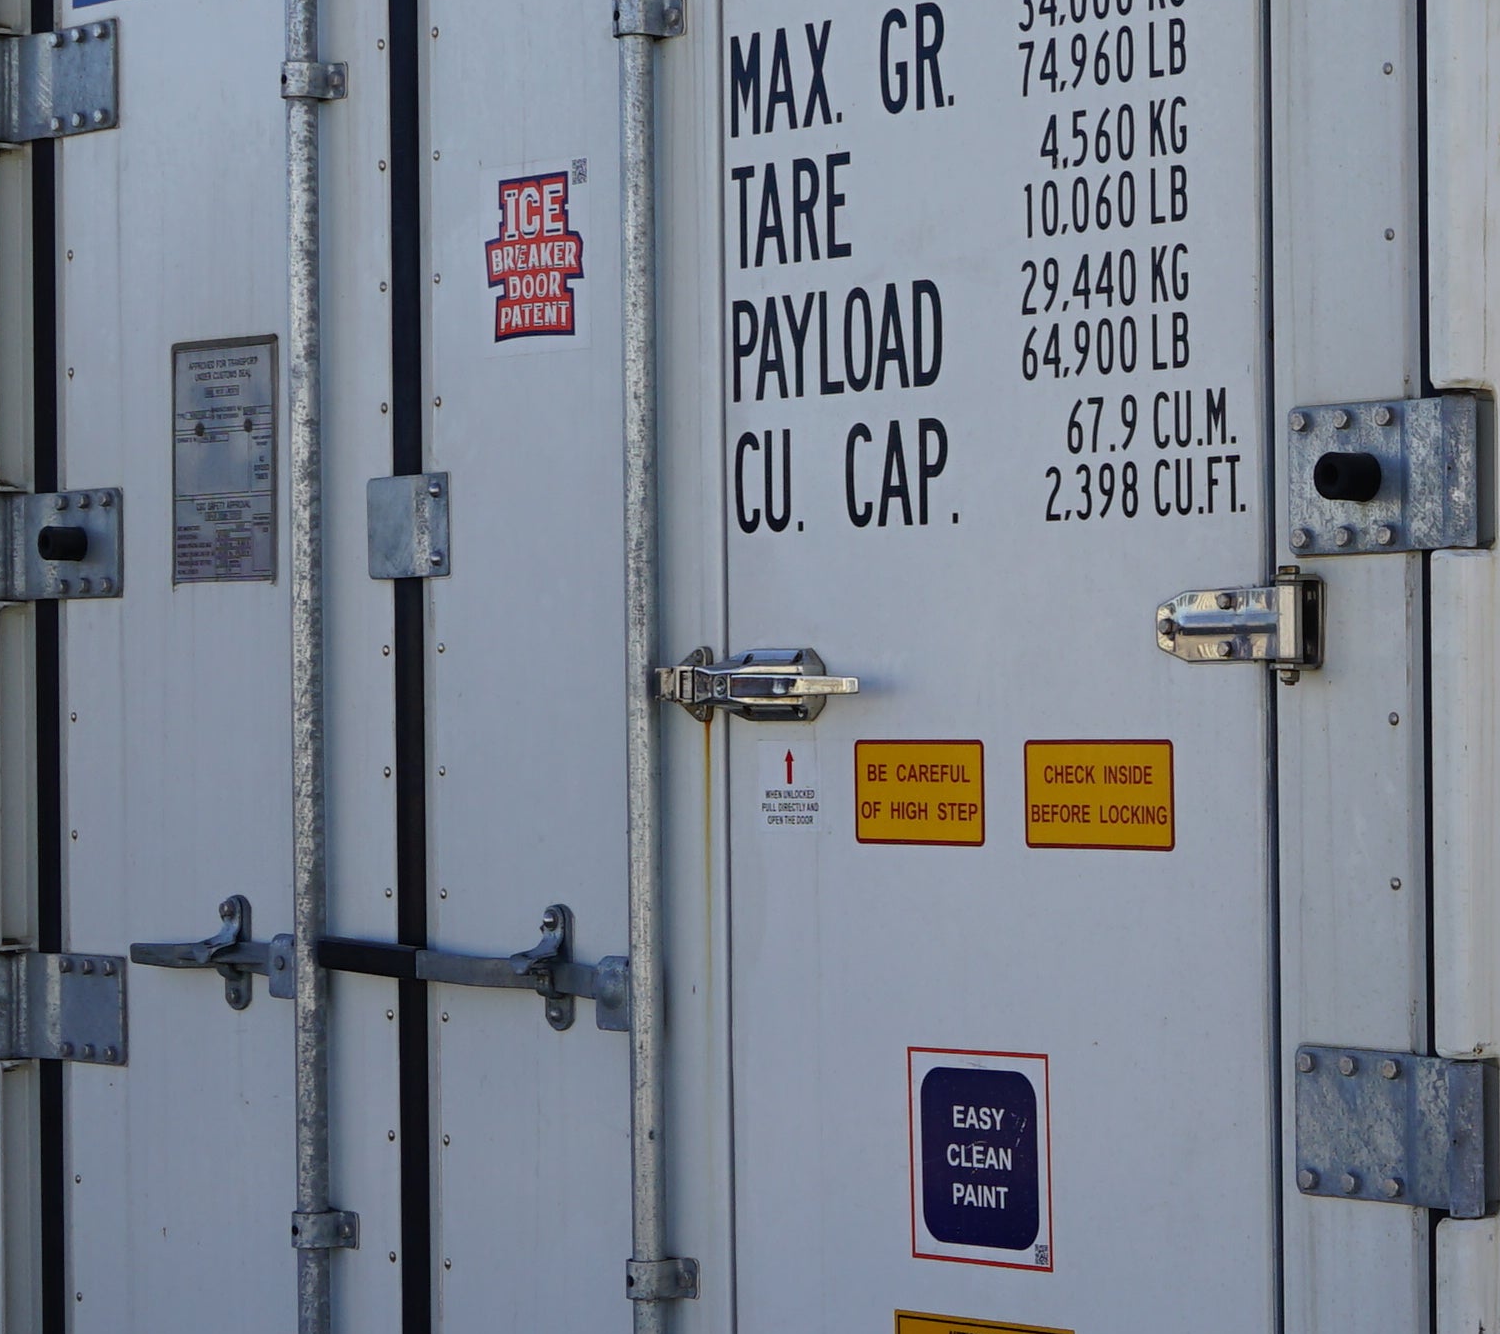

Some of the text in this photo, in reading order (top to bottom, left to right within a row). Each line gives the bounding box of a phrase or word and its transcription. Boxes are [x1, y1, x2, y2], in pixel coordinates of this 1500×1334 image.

[730, 2, 955, 138] MAX. GR.
[1018, 17, 1187, 97] 74,960 LB
[1040, 96, 1188, 170] 4,560 KG
[503, 182, 564, 242] ICE
[731, 151, 852, 269] TARE
[1024, 165, 1188, 239] 10,060 LB
[491, 241, 577, 276] BREAKER
[509, 271, 562, 301] DOOR
[1021, 243, 1190, 316] 29,440 KG
[500, 300, 570, 334] PATENT
[733, 279, 943, 403] PAYLOAD
[1022, 311, 1190, 381] 64,900 LB
[1067, 387, 1237, 454] 67.9 CU.M.
[735, 417, 960, 534] CU. CAP.
[1045, 454, 1247, 522] 2,398 CU.FT.
[868, 764, 971, 784] BE CAREFUL
[1044, 765, 1153, 785] CHECK INSIDE
[761, 802, 820, 812] PULL DIRECTLY AND
[765, 789, 815, 799] WHEN UNLOCKED
[861, 801, 978, 822] OF HIGH STEP
[767, 815, 814, 825] OPEN THE DOOR
[1031, 804, 1168, 825] BEFORE LOCKING
[952, 1105, 1005, 1131] EASY
[946, 1143, 1013, 1171] CLEAN
[952, 1183, 1009, 1210] PAINT
